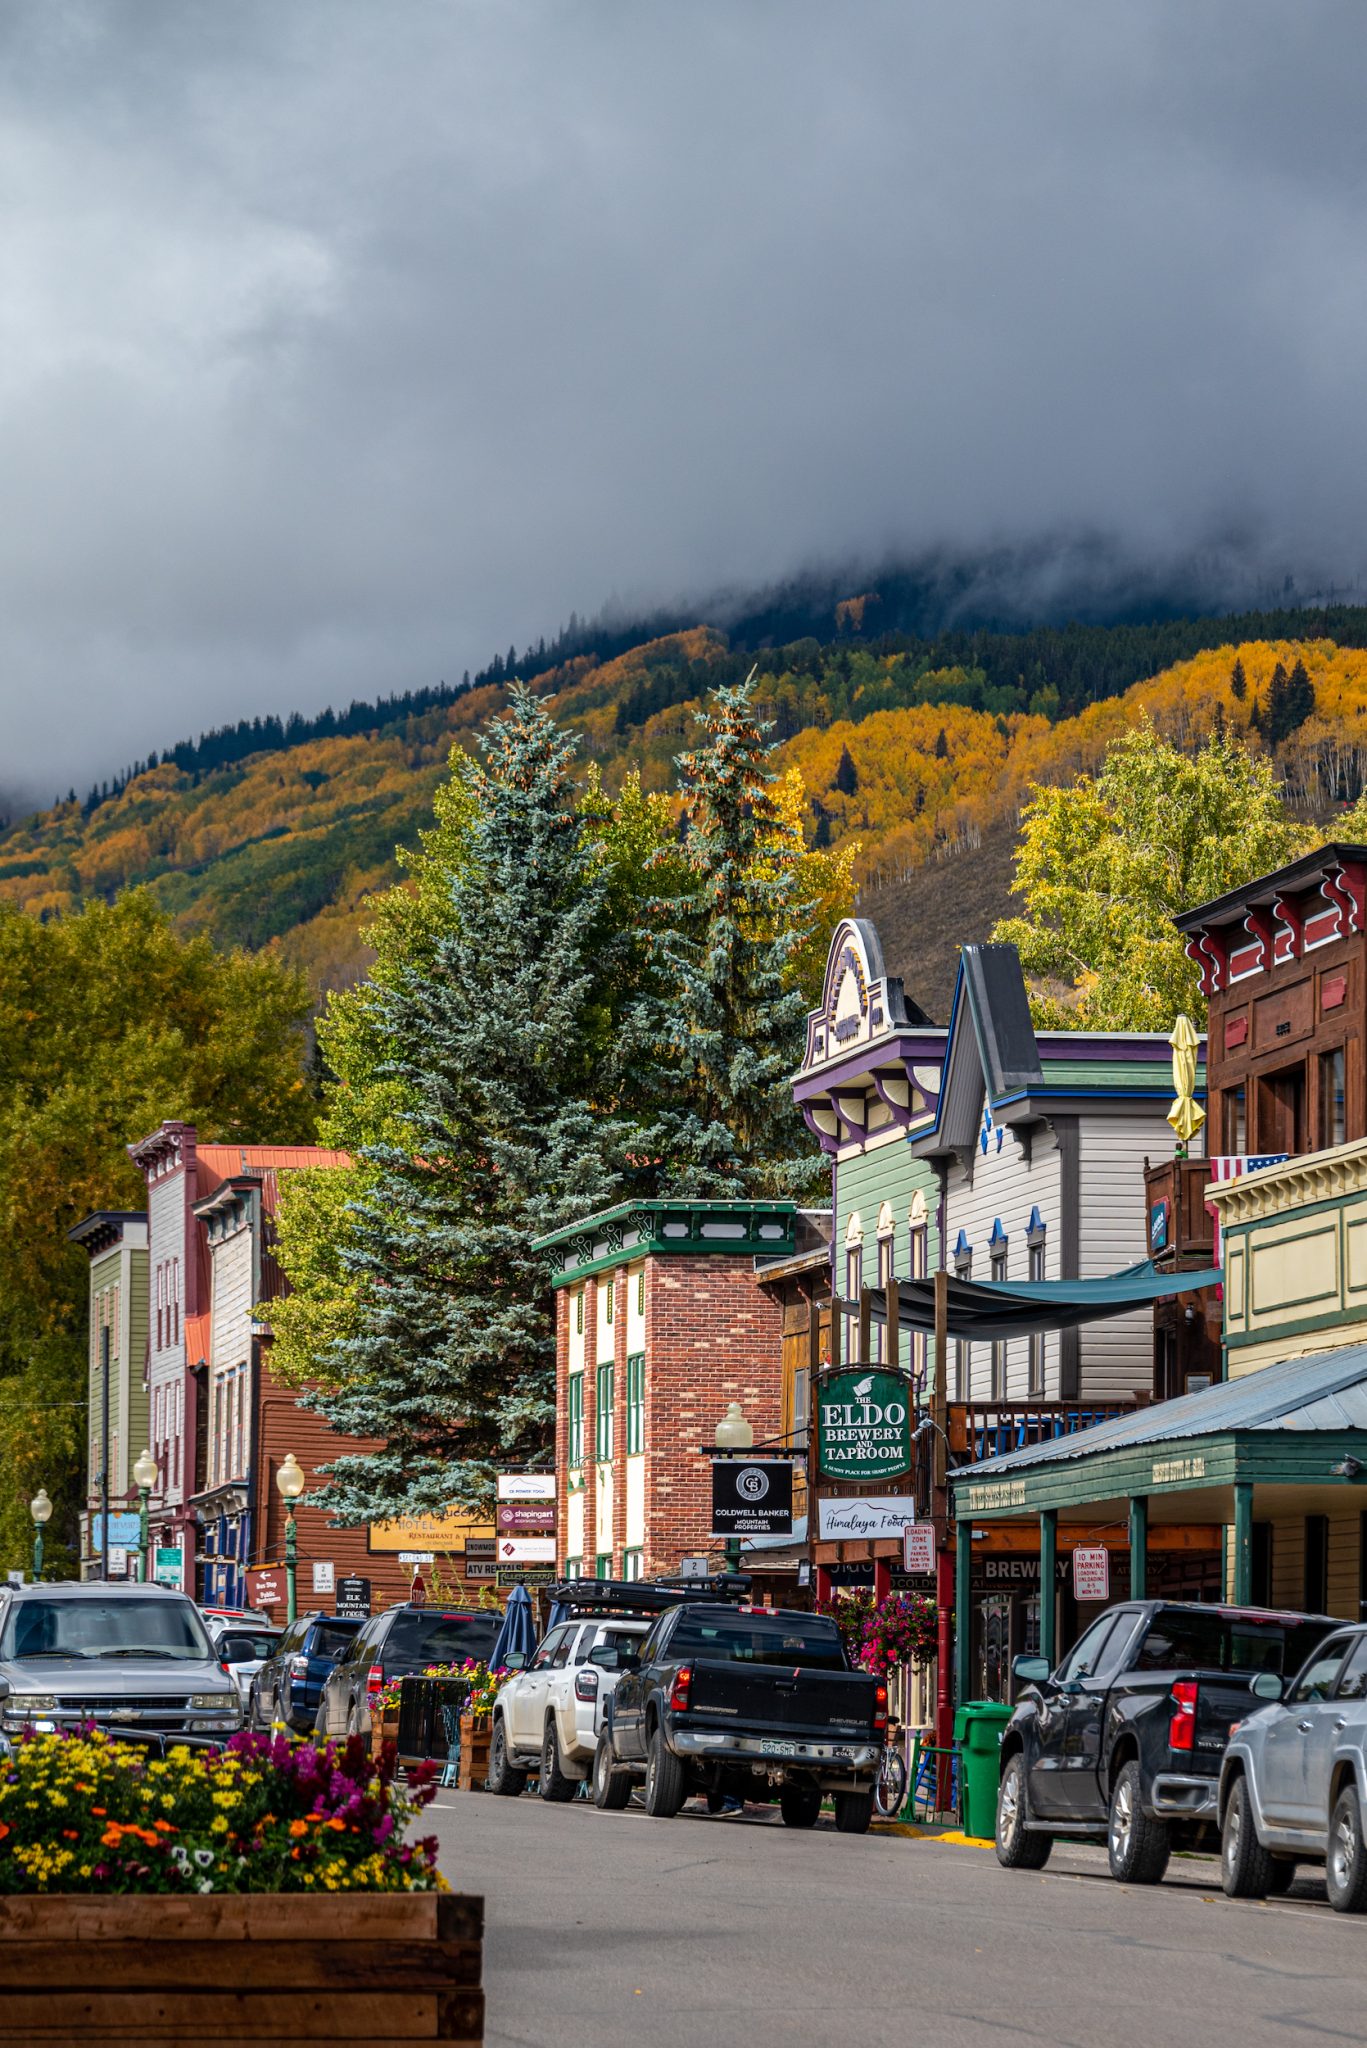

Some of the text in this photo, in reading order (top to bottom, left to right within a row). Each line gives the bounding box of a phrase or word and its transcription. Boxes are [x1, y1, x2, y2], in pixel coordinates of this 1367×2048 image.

[822, 1403, 905, 1426] ELDO
[826, 1428, 903, 1441] BREWERY
[825, 1447, 904, 1460] TAPROOM
[888, 1462, 906, 1472] PEOPLE
[399, 1521, 435, 1530] HOTEL
[827, 1514, 877, 1533] Himalaya
[468, 1564, 522, 1574] ATV RENTALS
[693, 1562, 697, 1570] 2
[256, 1596, 281, 1604] Restrooms
